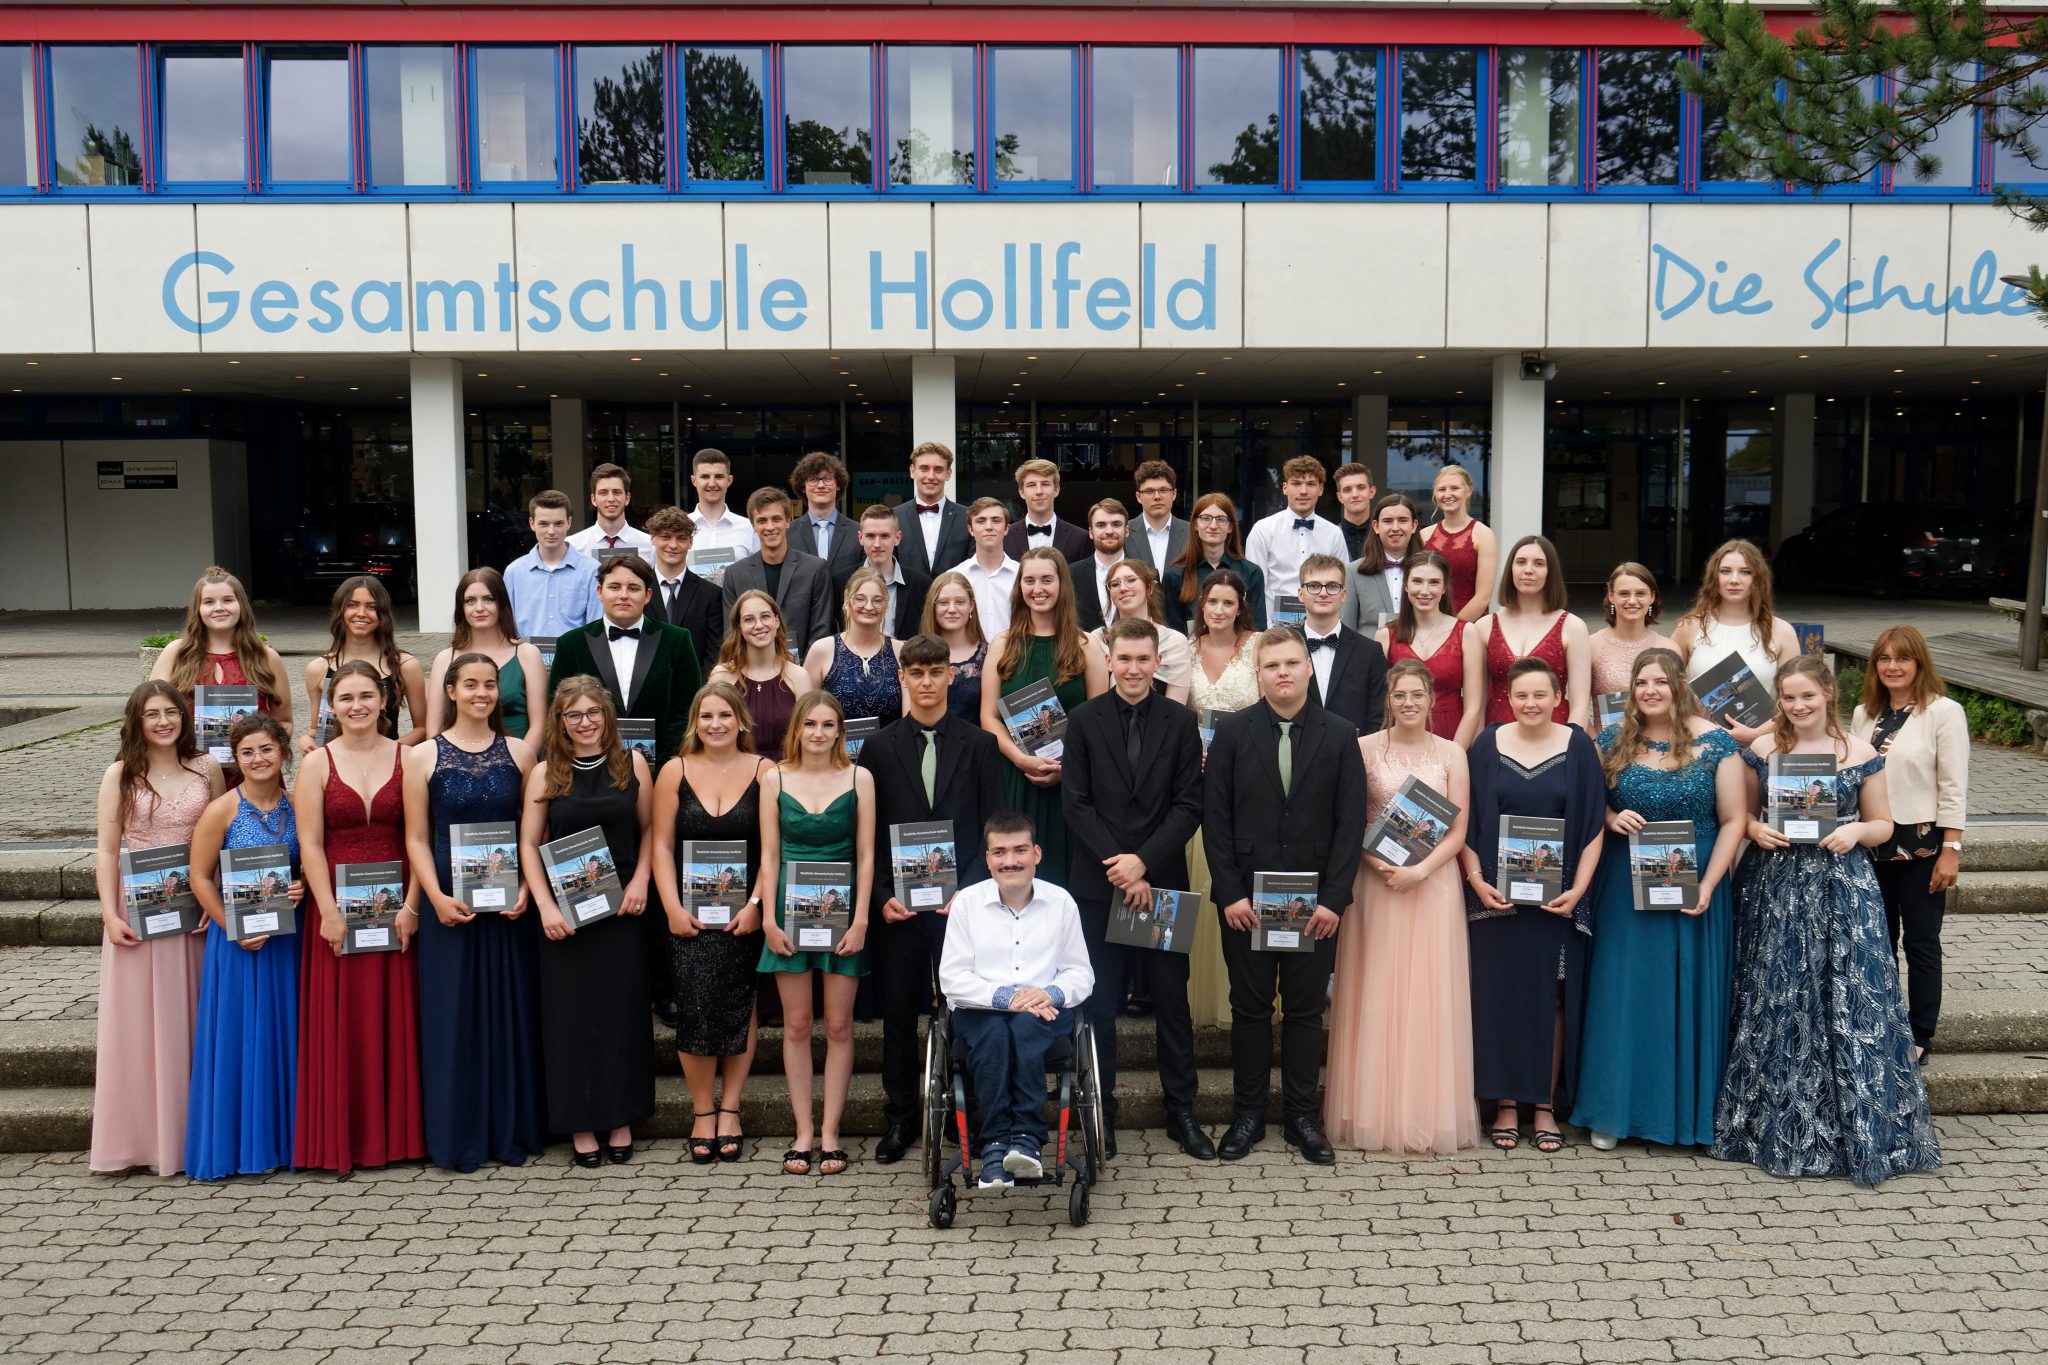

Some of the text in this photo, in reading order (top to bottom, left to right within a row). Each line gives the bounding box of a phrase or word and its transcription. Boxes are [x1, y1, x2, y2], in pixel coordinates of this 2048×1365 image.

[162, 242, 1217, 334] Gesamtschule Hollfeld
[1652, 238, 2036, 330] Die Schule
